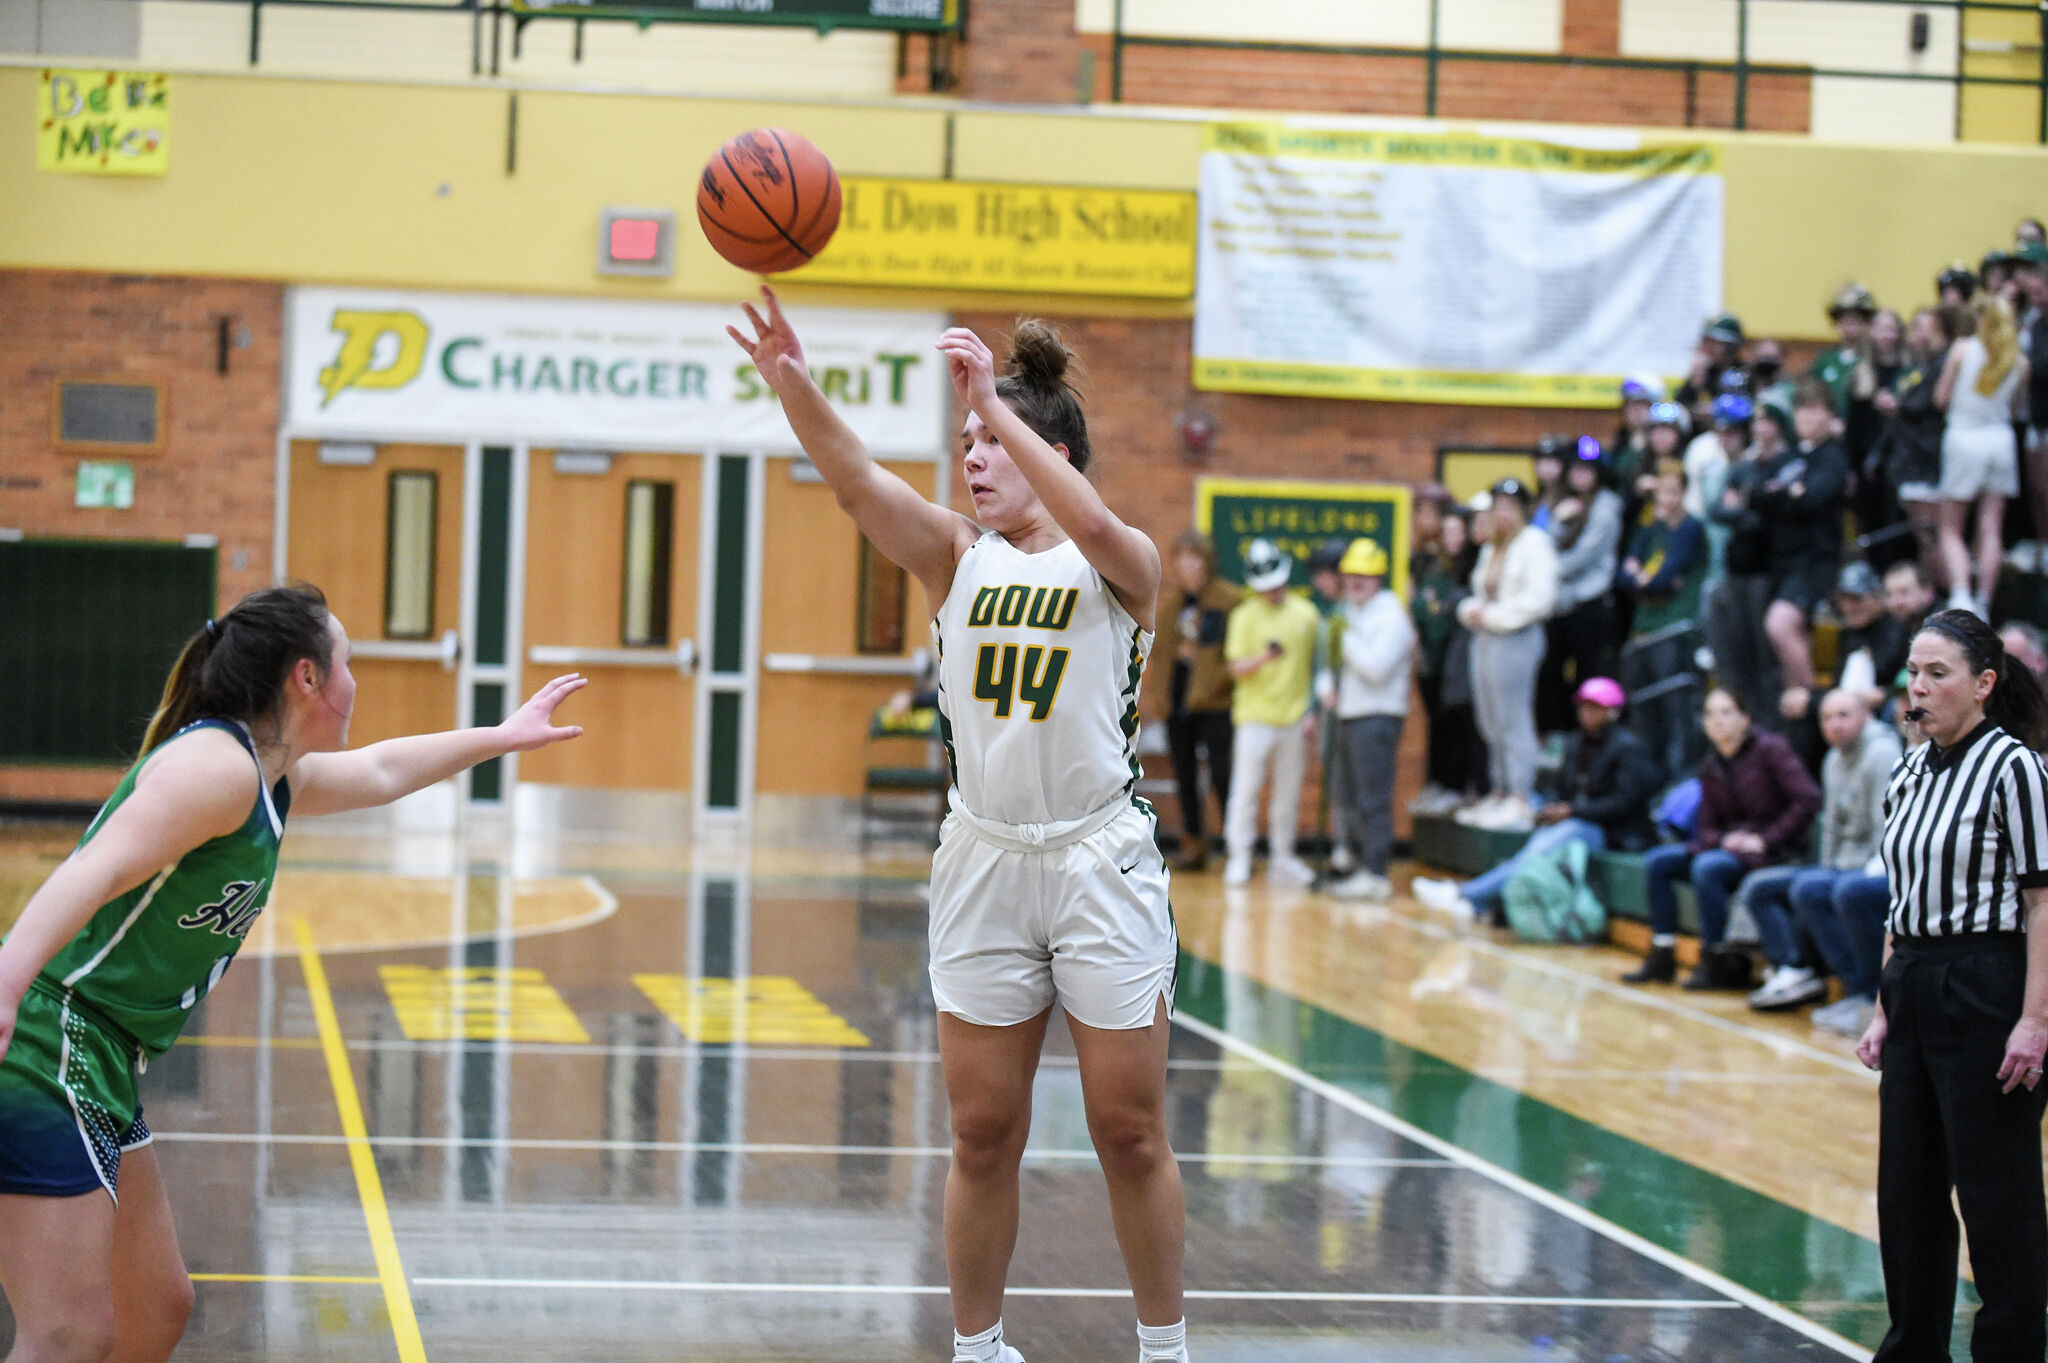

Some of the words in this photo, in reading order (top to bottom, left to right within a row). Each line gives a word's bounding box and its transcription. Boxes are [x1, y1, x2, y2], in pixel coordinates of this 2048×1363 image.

[881, 189, 960, 234] Dow
[974, 192, 1061, 247] High
[1073, 197, 1189, 246] School
[440, 336, 709, 400] CHARGER
[967, 584, 1081, 632] DOW
[972, 642, 1072, 723] 44
